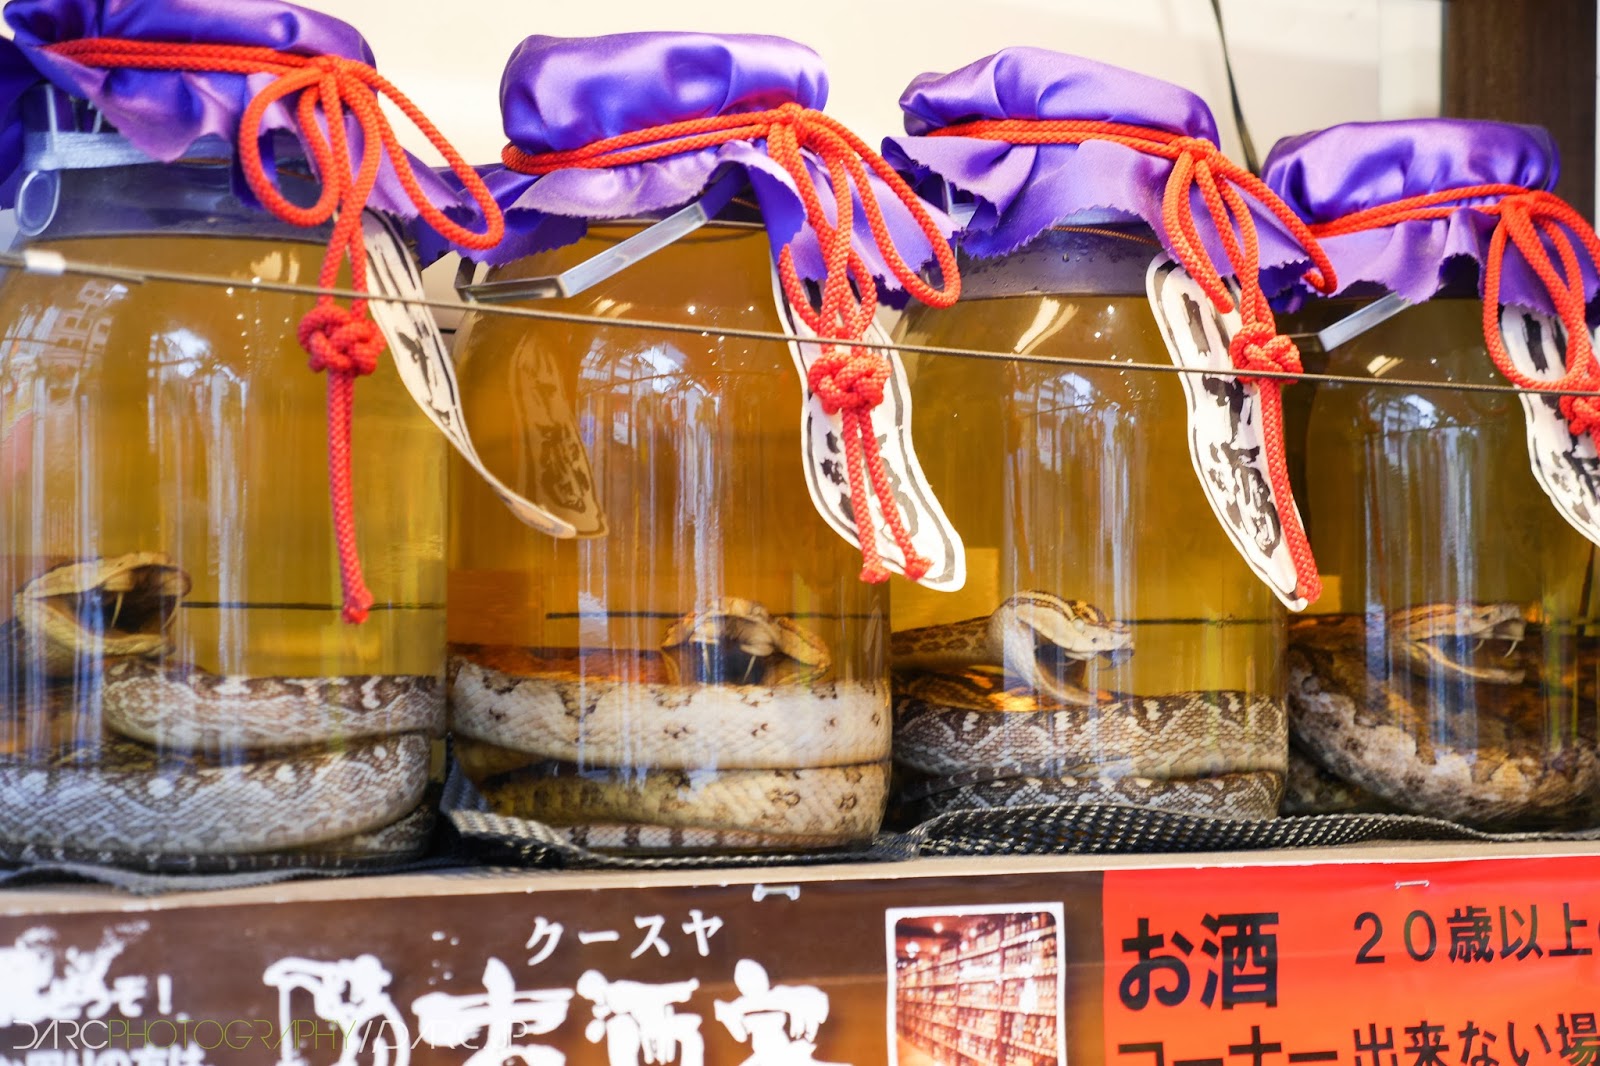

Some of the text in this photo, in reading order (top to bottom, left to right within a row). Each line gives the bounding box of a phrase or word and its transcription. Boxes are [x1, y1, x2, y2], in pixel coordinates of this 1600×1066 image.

[525, 908, 724, 967] クースヤ
[1118, 911, 1279, 1011] お酒
[1353, 902, 1600, 965] 20歳以上
[1353, 1012, 1600, 1066] 出来ない場
